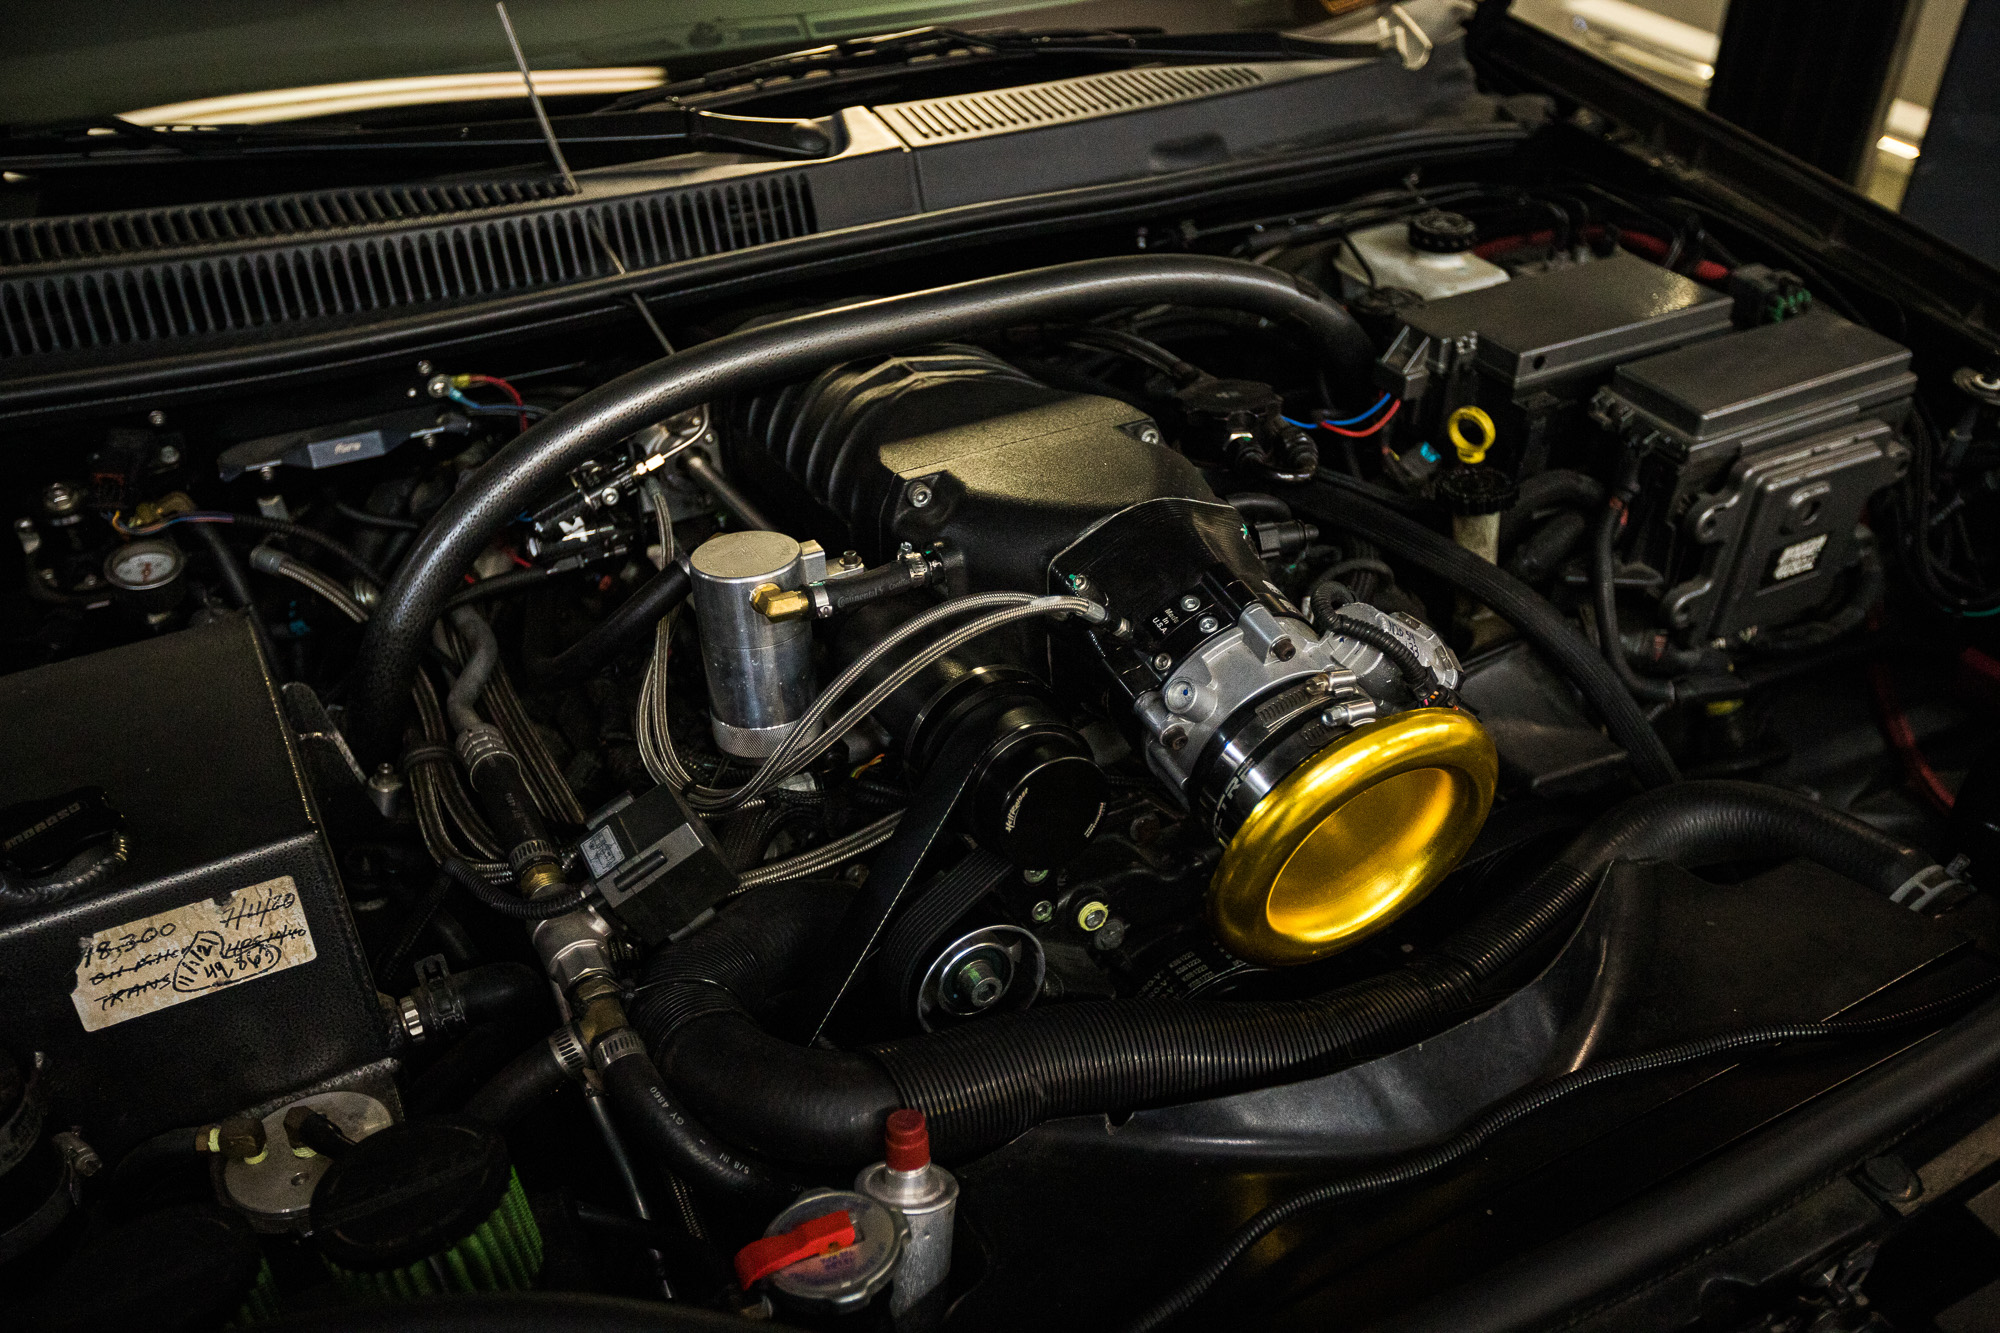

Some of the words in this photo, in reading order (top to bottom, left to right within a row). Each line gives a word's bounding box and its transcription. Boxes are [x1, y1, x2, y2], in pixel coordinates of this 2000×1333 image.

[1164, 608, 1179, 624] Made
[650, 1086, 670, 1108] 4860
[670, 1111, 685, 1126] GY
[719, 1152, 731, 1164] IN
[733, 1161, 750, 1175] 5/8
